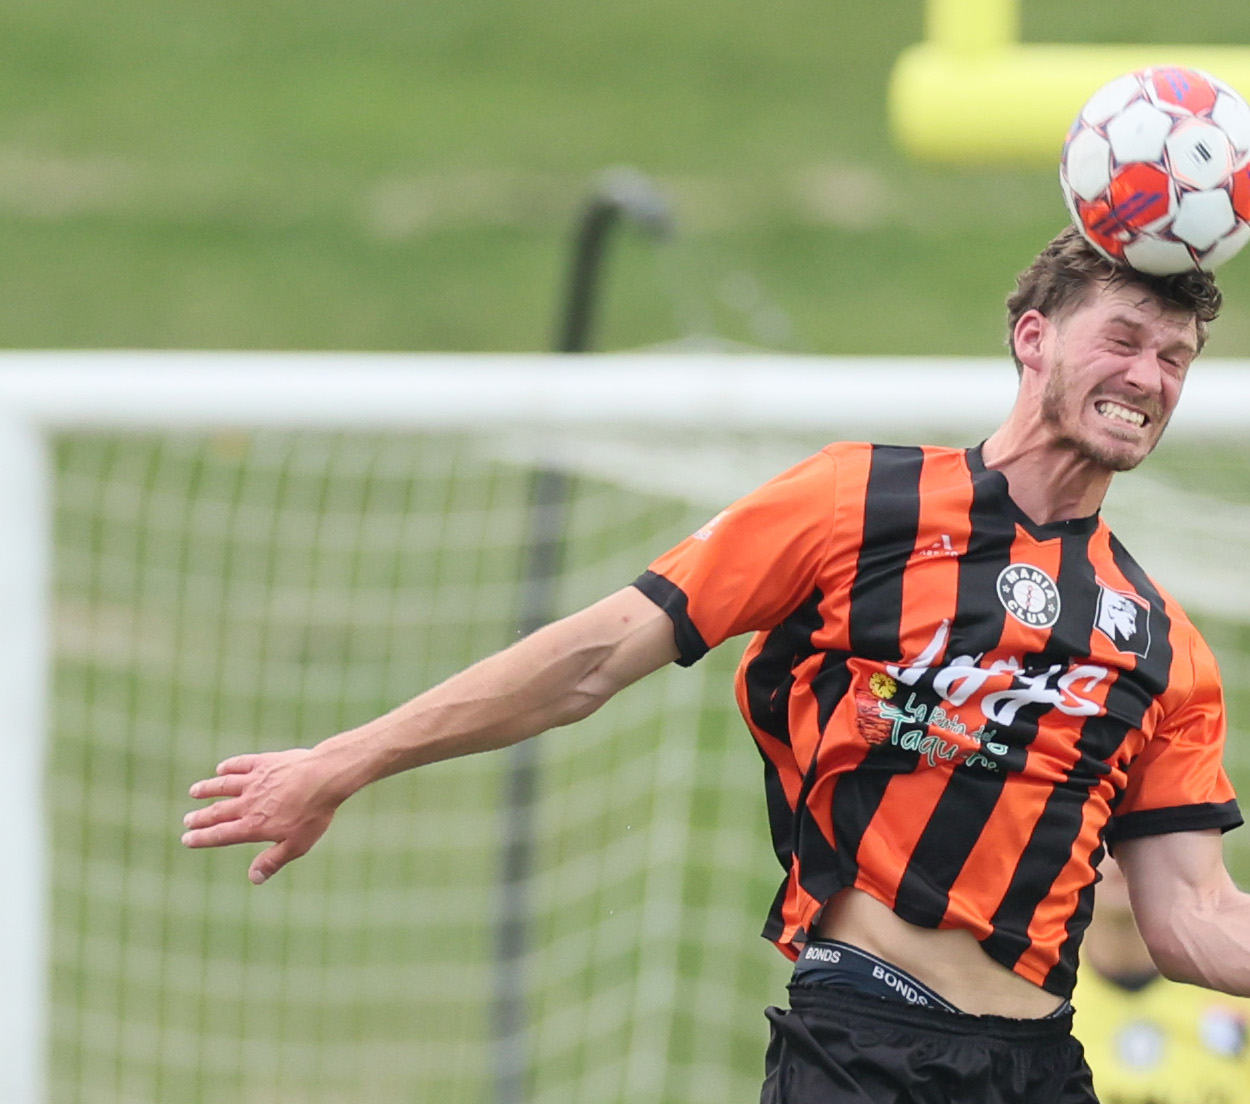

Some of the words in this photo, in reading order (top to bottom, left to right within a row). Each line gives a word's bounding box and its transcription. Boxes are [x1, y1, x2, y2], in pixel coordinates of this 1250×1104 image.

[1005, 568, 1056, 600] MANIA
[1007, 599, 1048, 624] CLUB
[904, 691, 928, 722] La
[805, 946, 842, 964] BONDS
[872, 964, 930, 1007] BONDS
